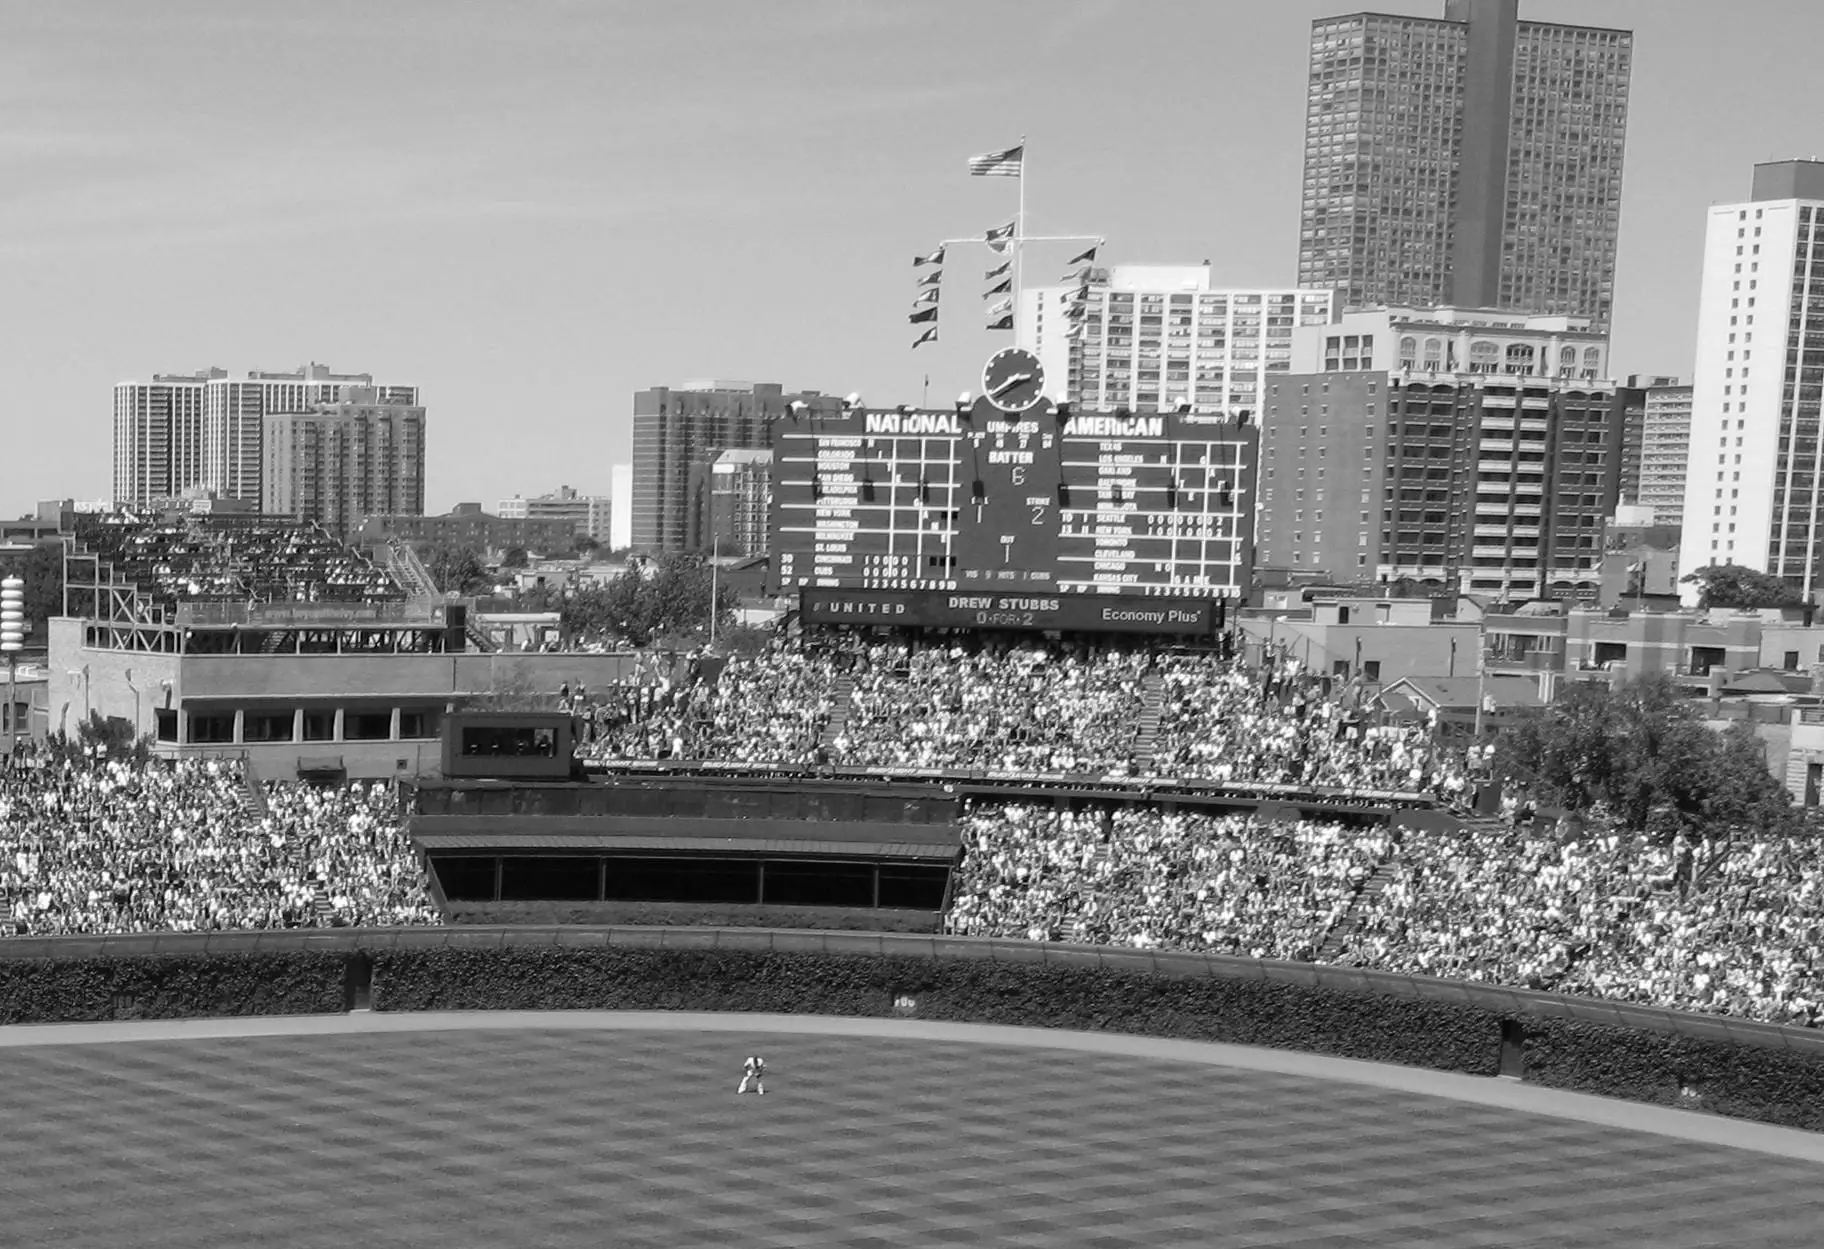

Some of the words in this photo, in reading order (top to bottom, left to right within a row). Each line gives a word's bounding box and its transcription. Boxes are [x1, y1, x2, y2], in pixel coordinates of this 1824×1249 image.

[866, 414, 962, 433] NATIONAL
[1063, 416, 1163, 436] AMERICAN
[988, 451, 1033, 464] BATTER
[1012, 467, 1025, 486] 6
[1031, 506, 1044, 524] 2
[1000, 535, 1015, 544] OUT
[826, 543, 847, 552] LOUIS
[864, 579, 868, 589] 1
[872, 579, 879, 589] 2
[882, 579, 888, 589] 3
[891, 579, 898, 589] 4
[901, 579, 907, 589] 5
[910, 579, 917, 589] 6
[920, 579, 926, 589] 7
[929, 579, 936, 589] 8
[939, 579, 945, 589] 9
[1145, 587, 1149, 597] 1
[1154, 587, 1160, 597] 2
[1164, 587, 1170, 597] 3
[1174, 587, 1180, 597] 4
[1183, 587, 1189, 597] 5
[1193, 587, 1199, 597] 6
[1203, 587, 1209, 597] 7
[1212, 587, 1219, 597] 8
[1222, 587, 1229, 597] 9
[830, 603, 905, 614] UNITED
[948, 597, 992, 609] DREW
[999, 598, 1059, 611] STUBBS
[1102, 608, 1165, 624] Economy
